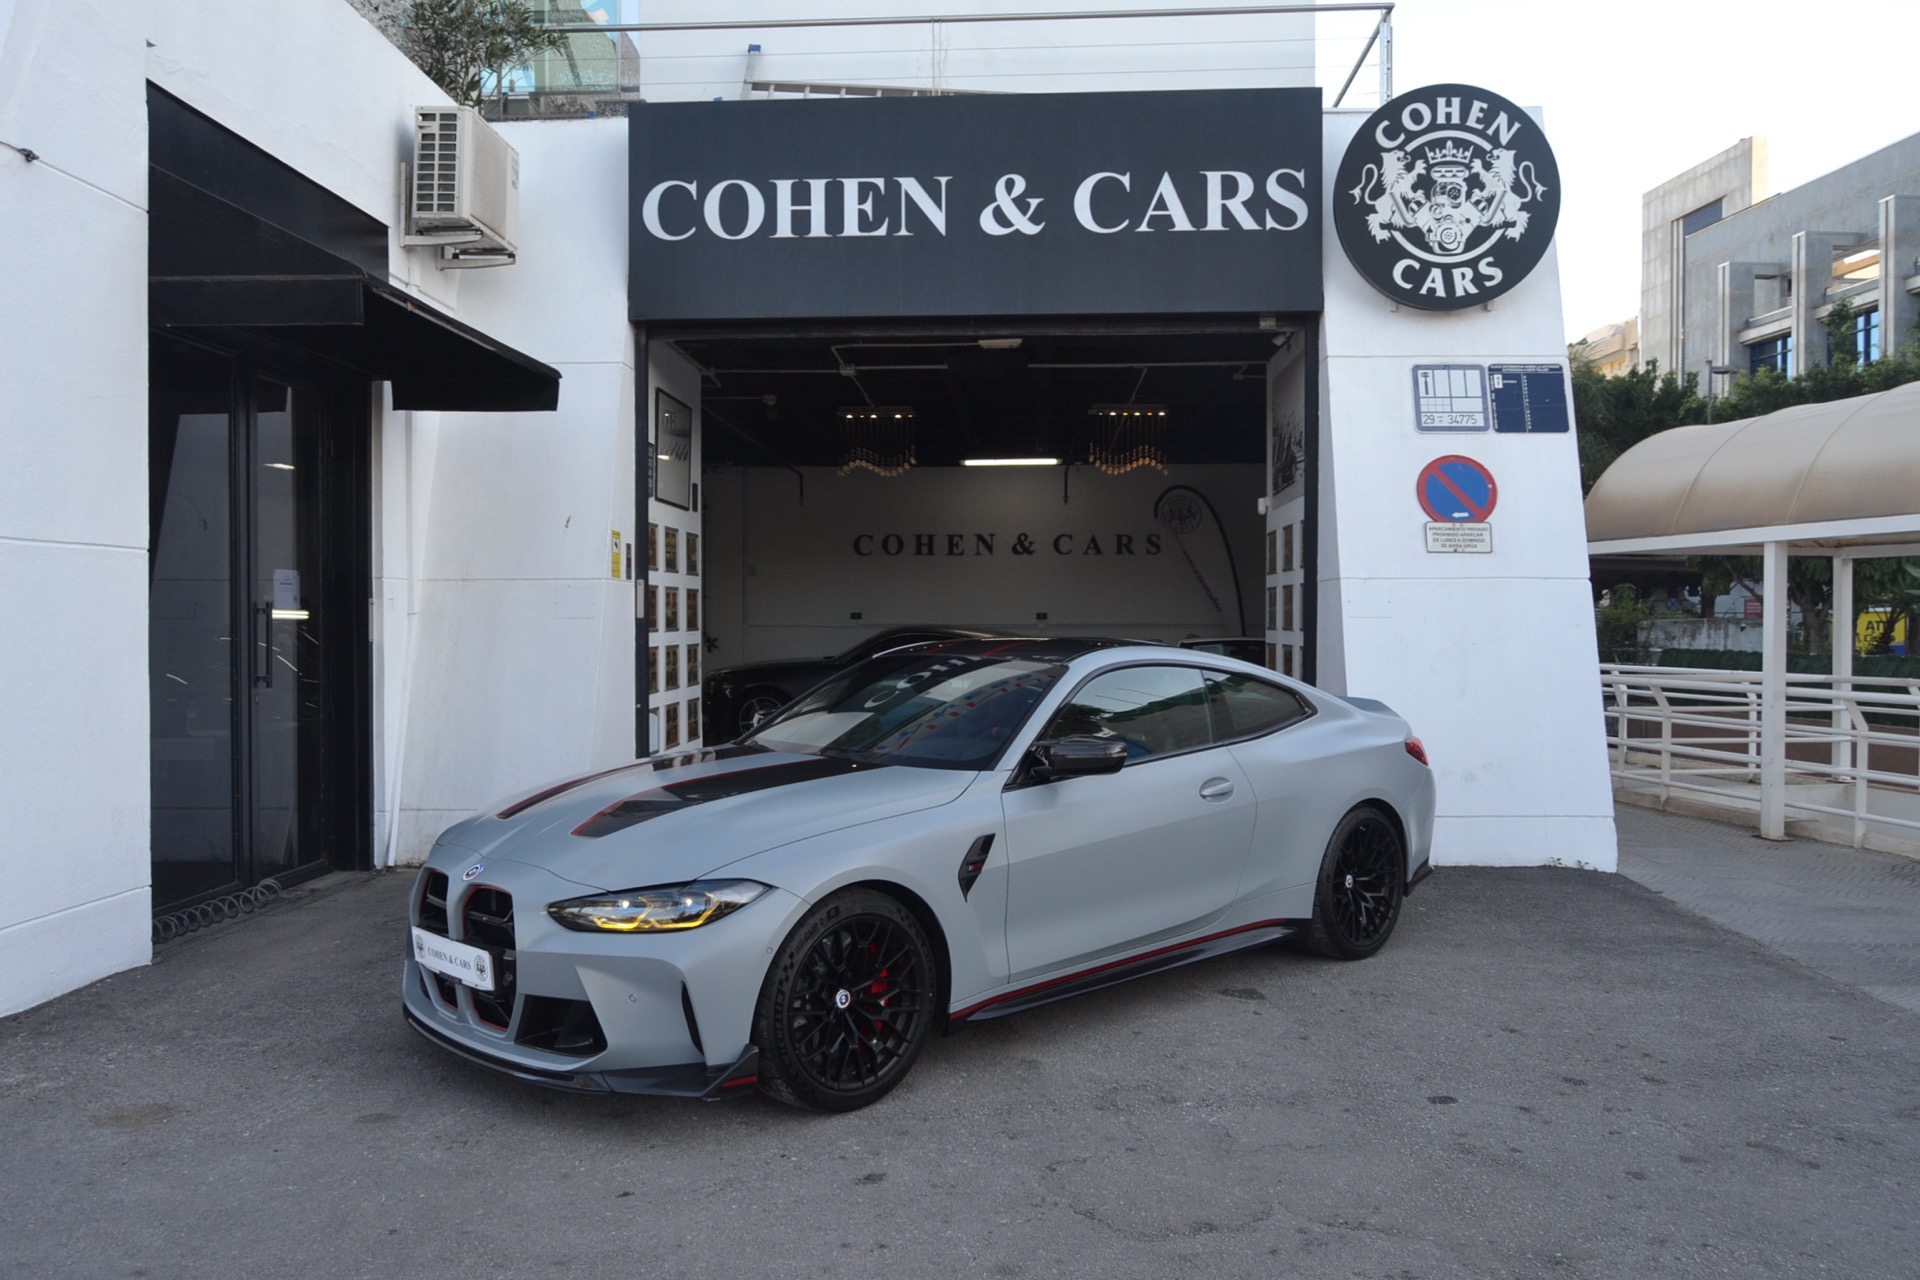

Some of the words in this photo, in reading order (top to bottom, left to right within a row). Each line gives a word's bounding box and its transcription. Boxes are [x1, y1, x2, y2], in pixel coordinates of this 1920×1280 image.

[1375, 96, 1522, 149] COHEN
[641, 175, 953, 241] COHEN
[979, 173, 1046, 236] &
[1073, 167, 1310, 233] CARS
[1392, 256, 1504, 298] CARS
[1422, 414, 1435, 425] 29
[1447, 414, 1478, 425] 34775
[852, 532, 996, 557] COHEN
[1011, 532, 1036, 556] &
[1052, 532, 1162, 556] CARS
[427, 946, 448, 961] COHEN
[454, 956, 472, 971] CARS
